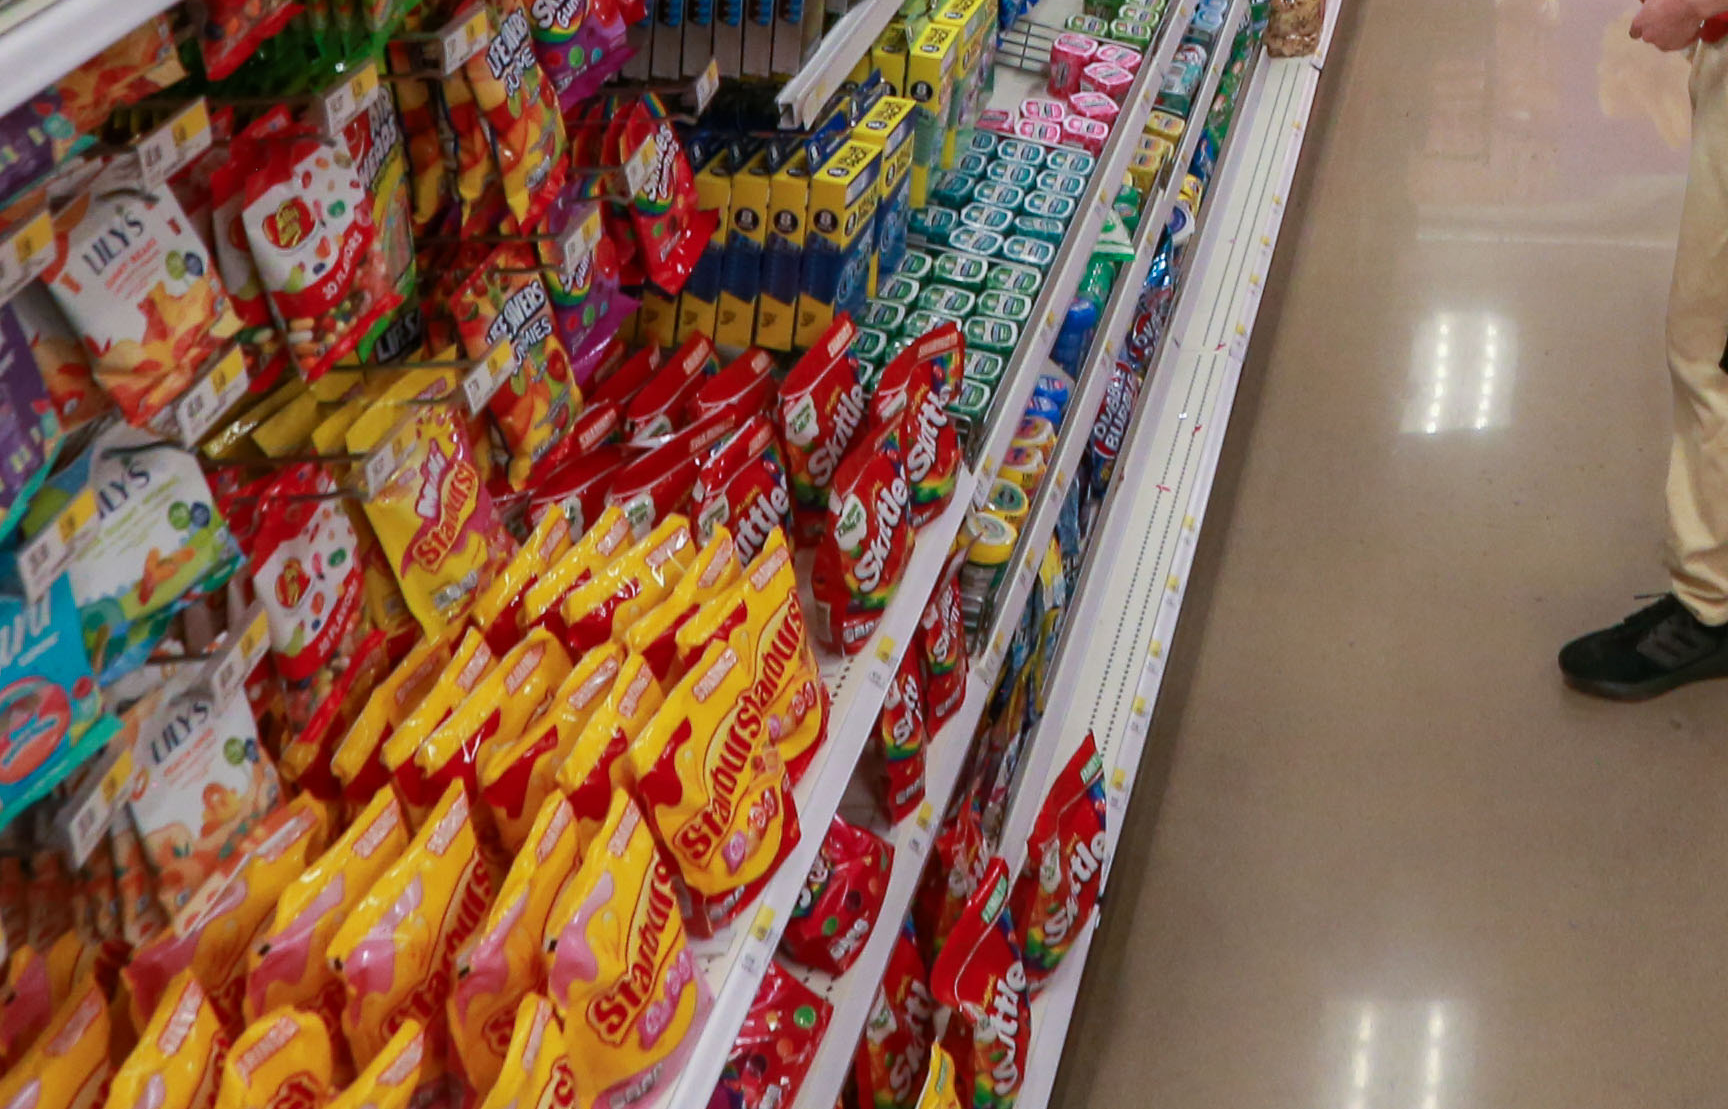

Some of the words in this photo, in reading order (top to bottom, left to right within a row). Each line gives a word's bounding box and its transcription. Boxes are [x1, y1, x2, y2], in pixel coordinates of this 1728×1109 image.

[81, 209, 147, 277] LILY'S
[806, 381, 865, 488] Skittle
[906, 384, 953, 484] Skittle
[99, 459, 151, 521] ILY'S
[852, 465, 910, 594] Skittle
[735, 598, 804, 740] Starburs
